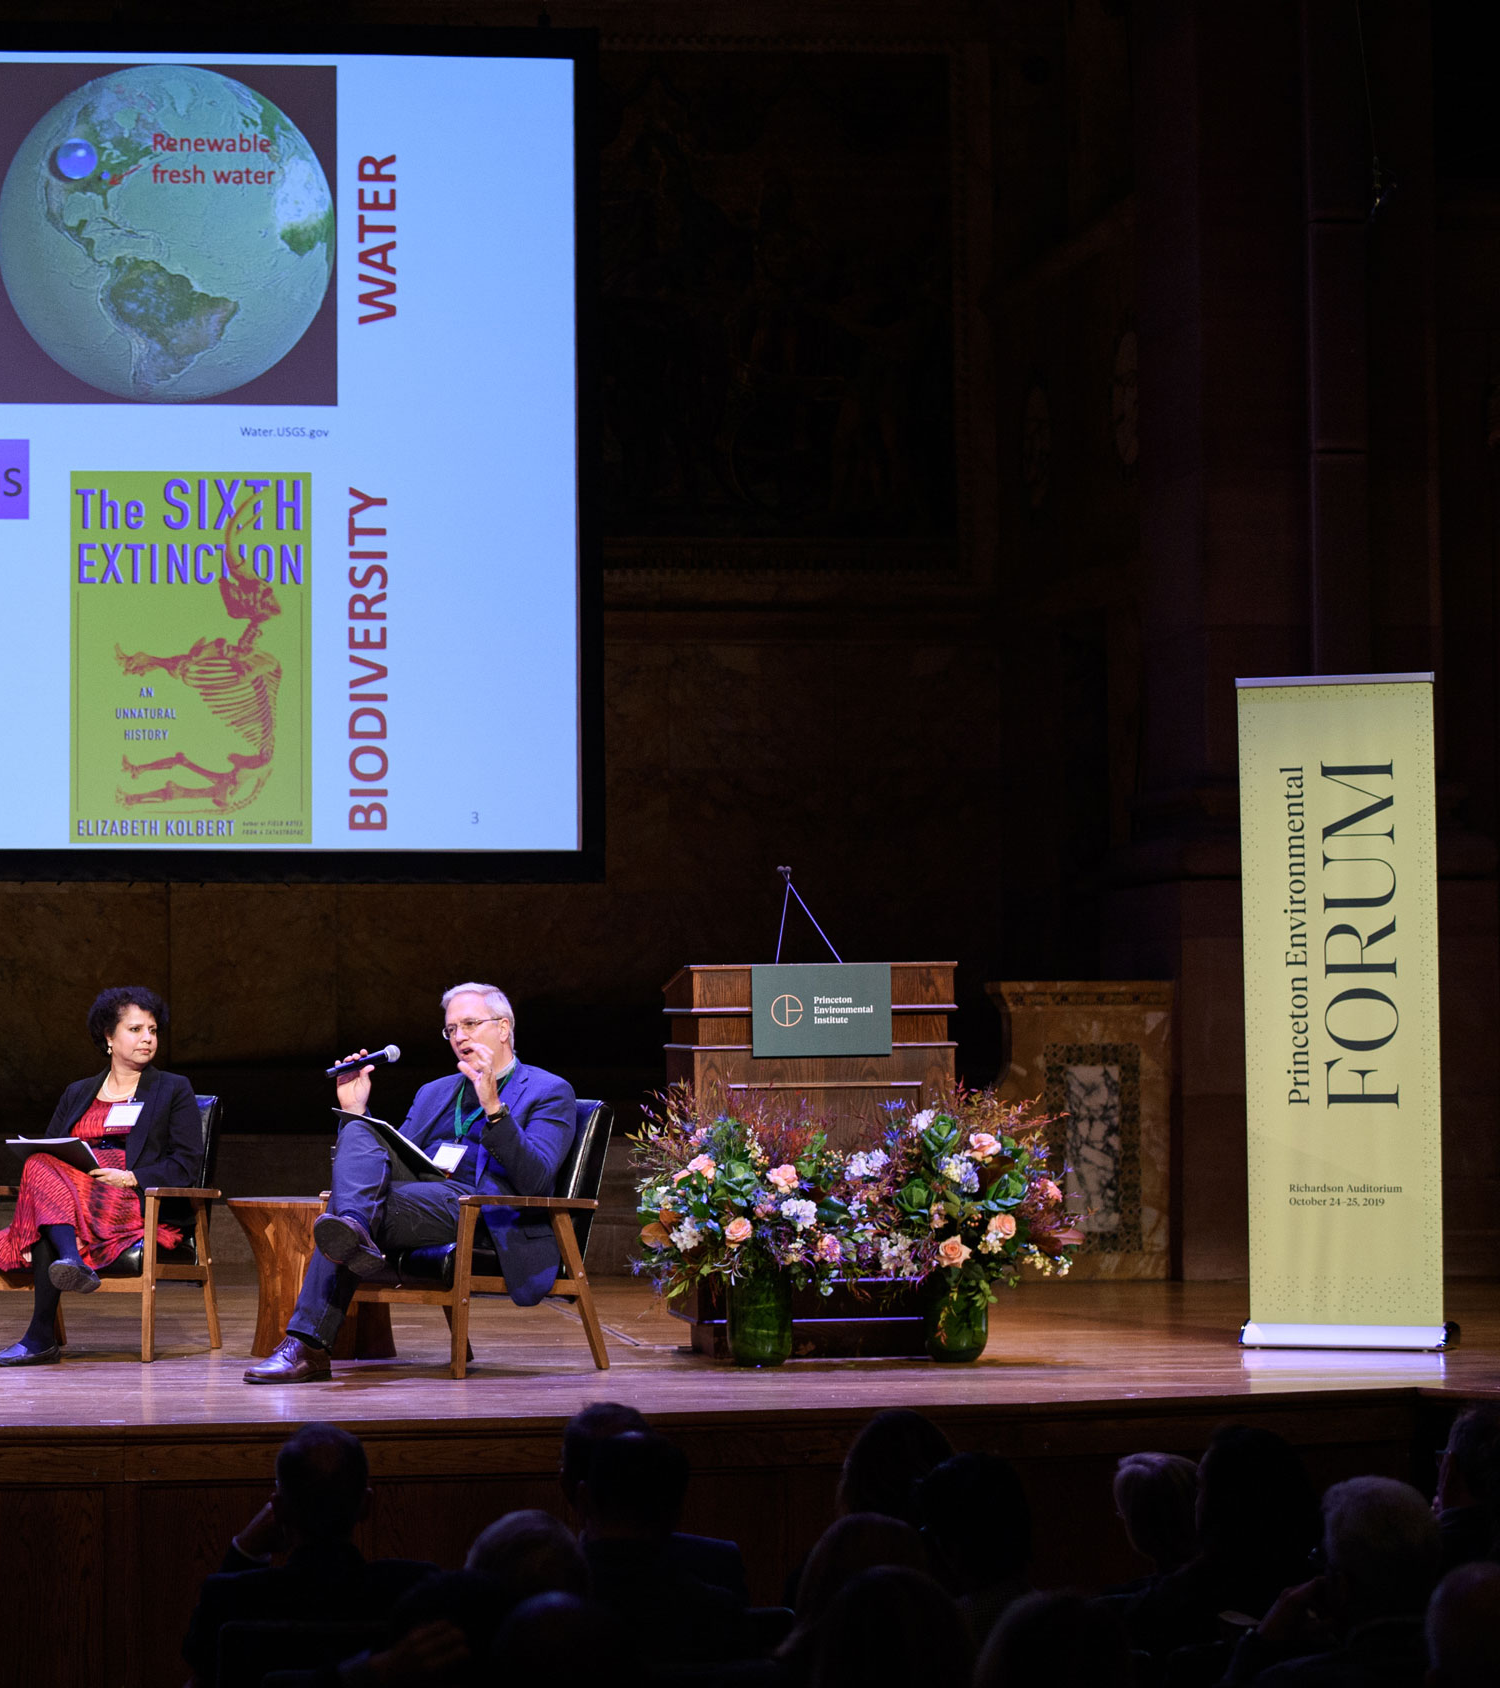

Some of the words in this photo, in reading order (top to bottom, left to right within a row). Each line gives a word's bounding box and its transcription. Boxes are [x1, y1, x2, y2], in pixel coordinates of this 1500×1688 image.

[152, 133, 271, 154] Renewable
[152, 164, 207, 185] fresh
[214, 168, 276, 185] water
[357, 153, 398, 325] WATER
[240, 426, 330, 439] Water.USGS.gov
[75, 488, 146, 530] The
[163, 478, 304, 531] SIXTH
[347, 486, 390, 831] BIODIVERSITY
[140, 687, 154, 698] AN
[116, 708, 177, 720] UNNATURAL
[124, 729, 169, 741] HISTORY
[471, 811, 479, 824] 3
[77, 819, 160, 837] ELIZABETH
[165, 819, 236, 837] KOLBERT
[1279, 765, 1308, 968] Environmental
[1320, 758, 1400, 1110] FORUM
[813, 996, 853, 1004] Princeton
[813, 1005, 873, 1014] Environmental
[814, 1015, 849, 1024] Institute
[1287, 972, 1310, 1106] Princeton
[1289, 1183, 1344, 1193] Richardson
[1347, 1183, 1403, 1193] Auditorium
[1289, 1197, 1327, 1206] October
[1363, 1197, 1385, 1206] 2019
